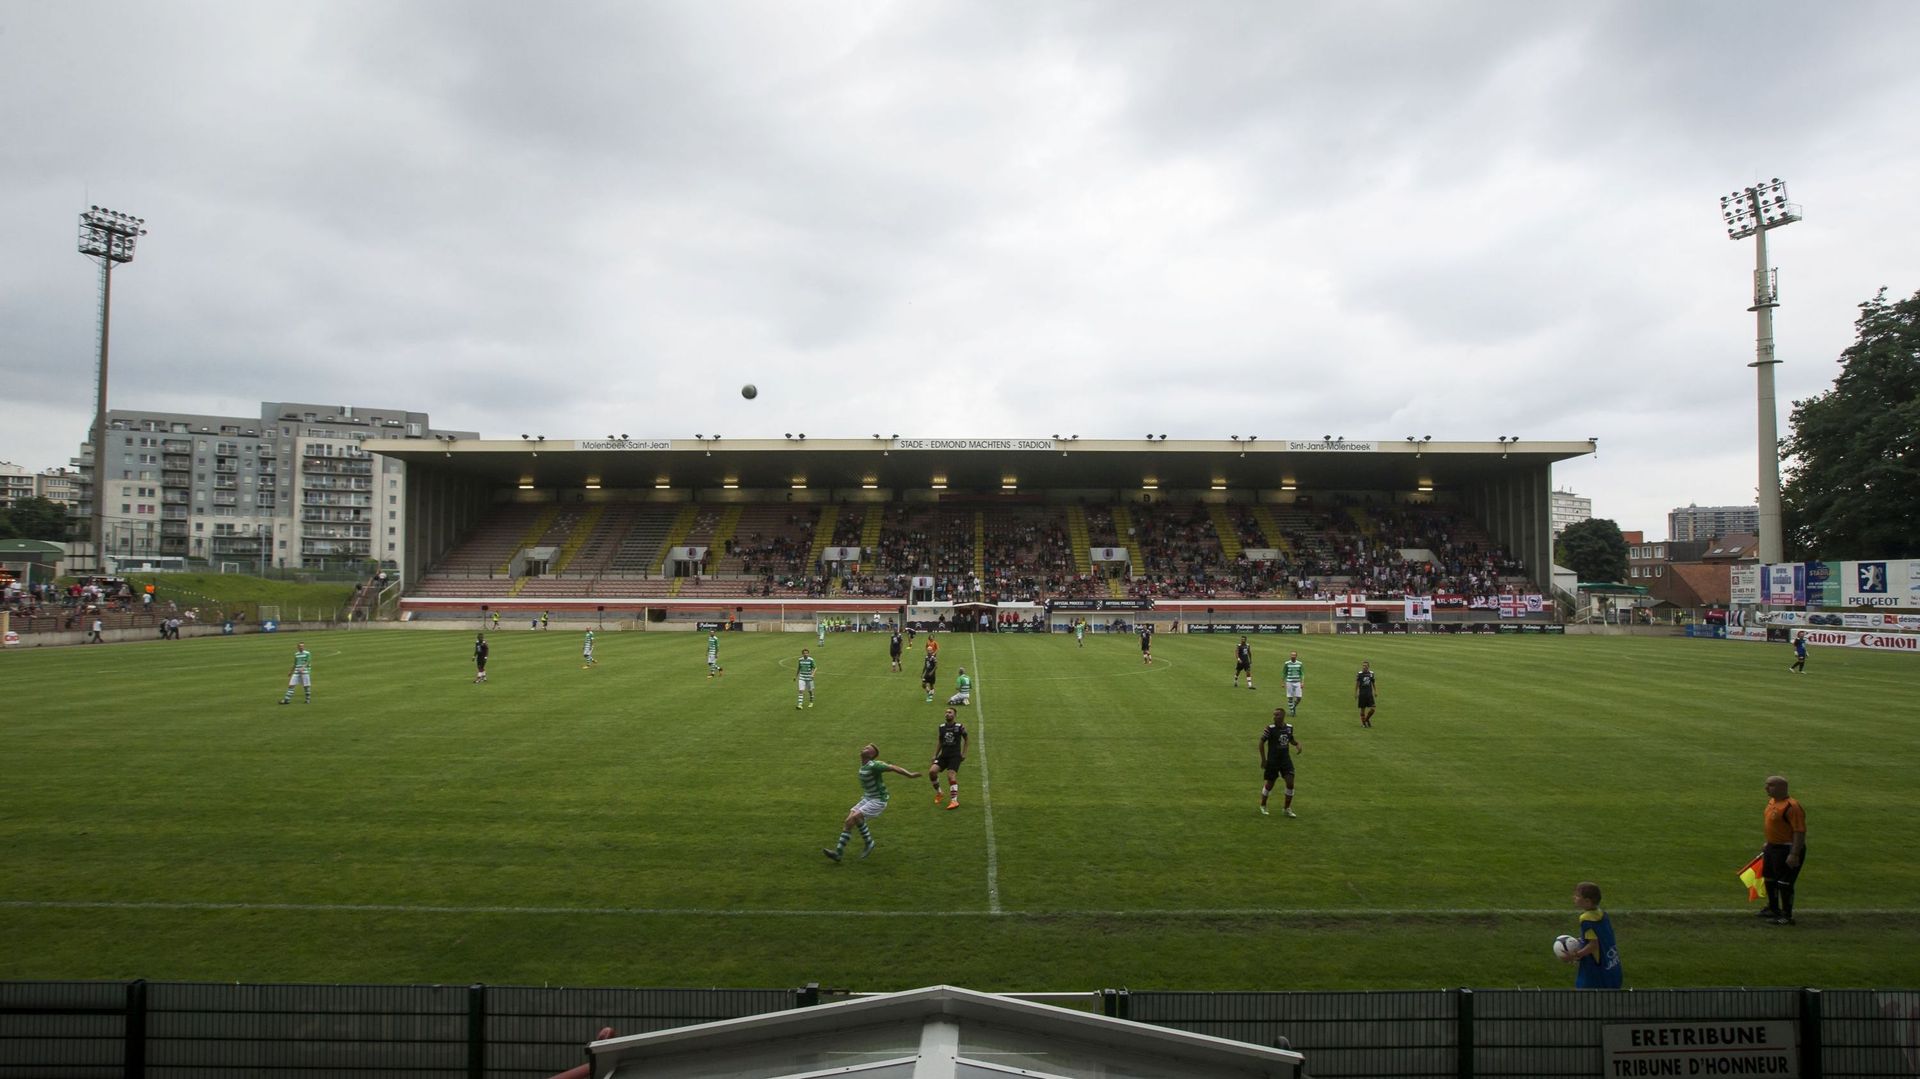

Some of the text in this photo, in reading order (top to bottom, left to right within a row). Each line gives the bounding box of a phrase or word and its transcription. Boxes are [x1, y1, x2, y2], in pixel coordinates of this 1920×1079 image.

[582, 441, 669, 449] Molenbeek-Saint-Jean
[900, 440, 923, 448] STADE
[930, 440, 966, 448] EDMOND
[1290, 442, 1370, 450] Sint-Jans-Molenbeek
[1848, 597, 1900, 606] PEUGEOT
[1860, 633, 1917, 649] Canon
[1631, 1026, 1767, 1046] ERETRIBUNE
[1612, 1056, 1789, 1077] TRIBUNE D'HONNEUR
